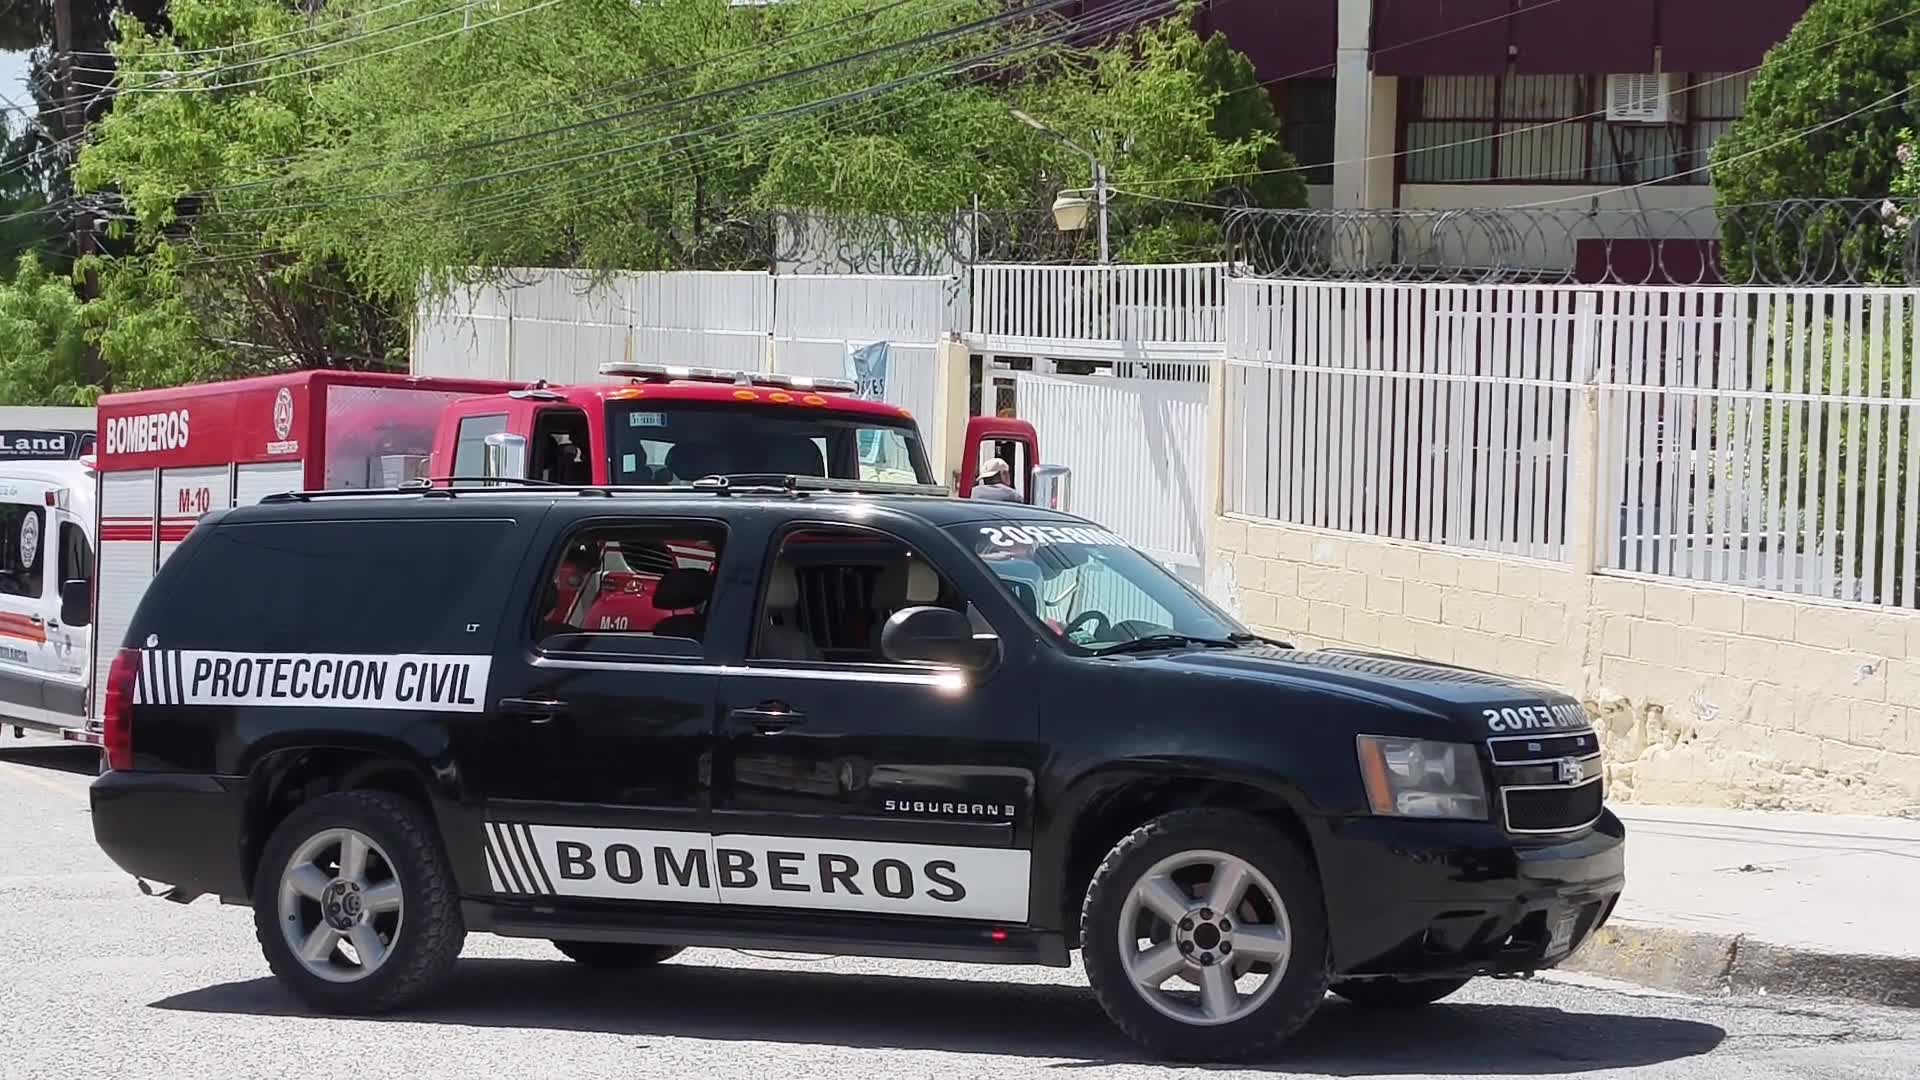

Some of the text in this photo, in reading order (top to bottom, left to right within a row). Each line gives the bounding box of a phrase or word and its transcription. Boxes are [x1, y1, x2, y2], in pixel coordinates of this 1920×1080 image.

[106, 409, 190, 454] BOMBEROS
[0, 435, 65, 450] Land
[179, 487, 210, 513] M-10
[466, 623, 480, 632] LT
[600, 615, 628, 630] M-10
[192, 658, 475, 704] PROTECCION CIVIL
[884, 800, 998, 815] SUBURBAN
[556, 840, 967, 902] BOMBEROS
